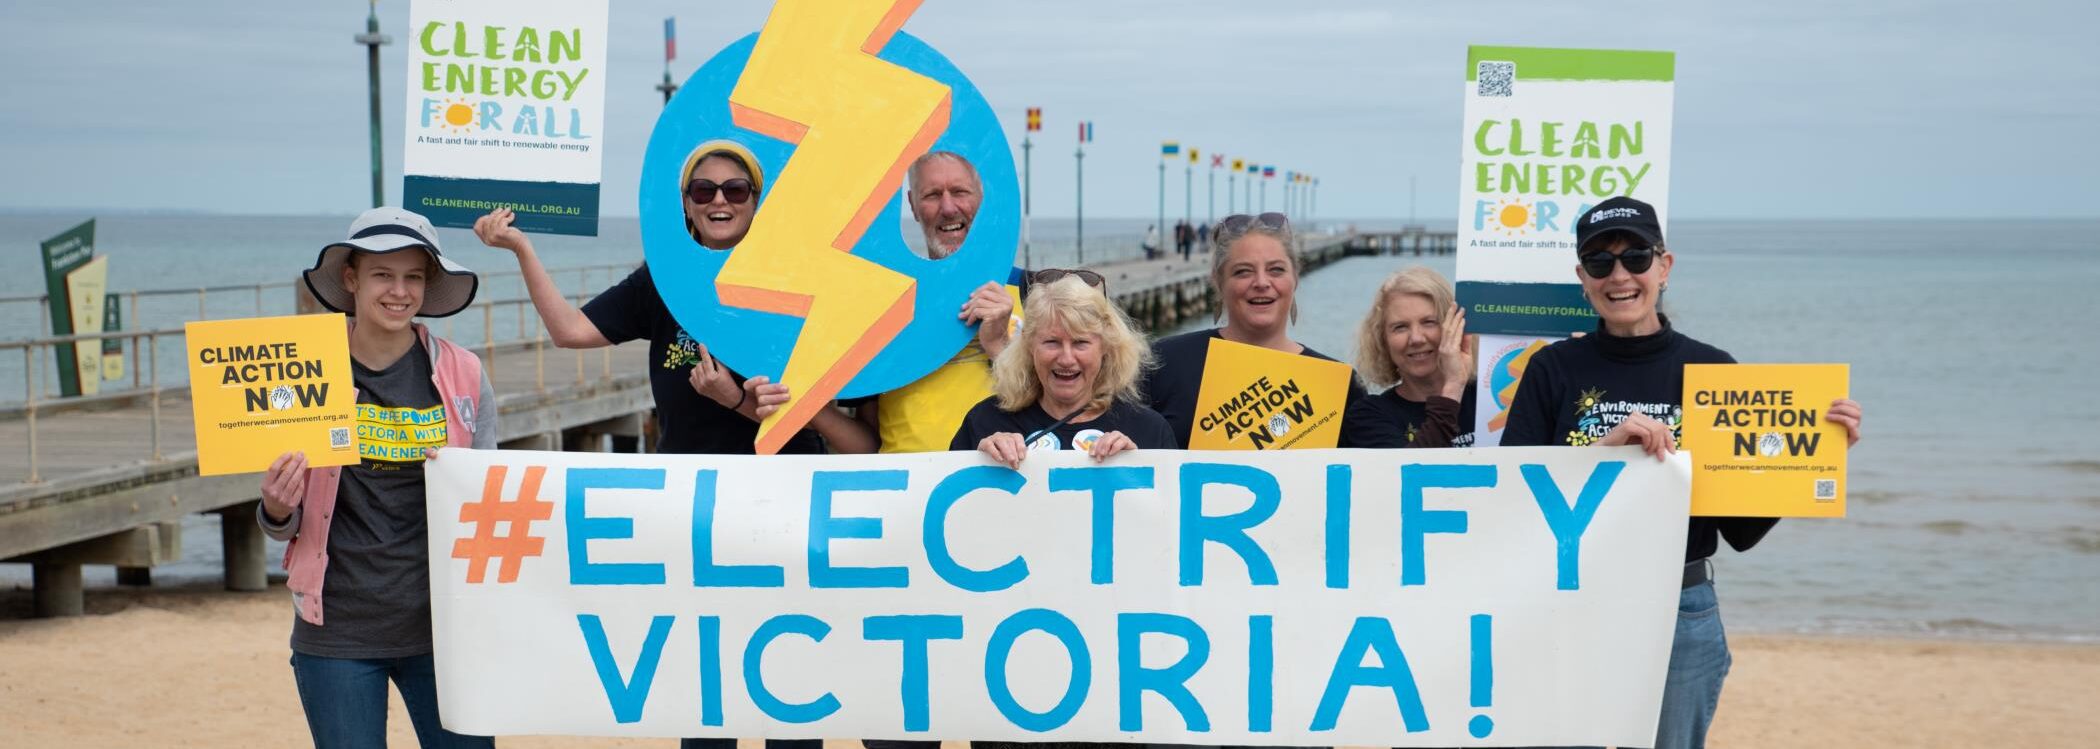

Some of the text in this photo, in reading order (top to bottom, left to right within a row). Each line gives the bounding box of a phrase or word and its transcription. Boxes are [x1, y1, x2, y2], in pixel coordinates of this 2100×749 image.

[420, 21, 581, 64] CLEAN
[422, 61, 589, 101] ENERGY
[512, 104, 592, 139] ALL
[417, 135, 590, 152] A fast and fair shift to renewable energy
[1474, 118, 1643, 159] CLEAN
[1475, 162, 1651, 198] ENERGY
[1470, 239, 1477, 247] A
[1479, 239, 1497, 247] fast
[1500, 239, 1516, 248] and
[1518, 240, 1534, 248] fair
[1536, 240, 1556, 248] shift
[200, 342, 298, 364] CLIMATE
[222, 359, 323, 385] ACTION
[1200, 376, 1272, 431] CLIMATE
[1224, 379, 1300, 440] ACTION
[1592, 401, 1670, 415] ENVIRONMENT
[1695, 390, 1793, 406] CLIMATE
[219, 413, 349, 430] togetherwecanmovement.org.au
[1713, 409, 1816, 427] ACTION
[414, 427, 446, 439] WITH
[1704, 463, 1837, 473] togetherwecanmovement.org.au
[451, 461, 1626, 592] #ELECTRIFY
[576, 608, 1494, 739] VICTORIA!
